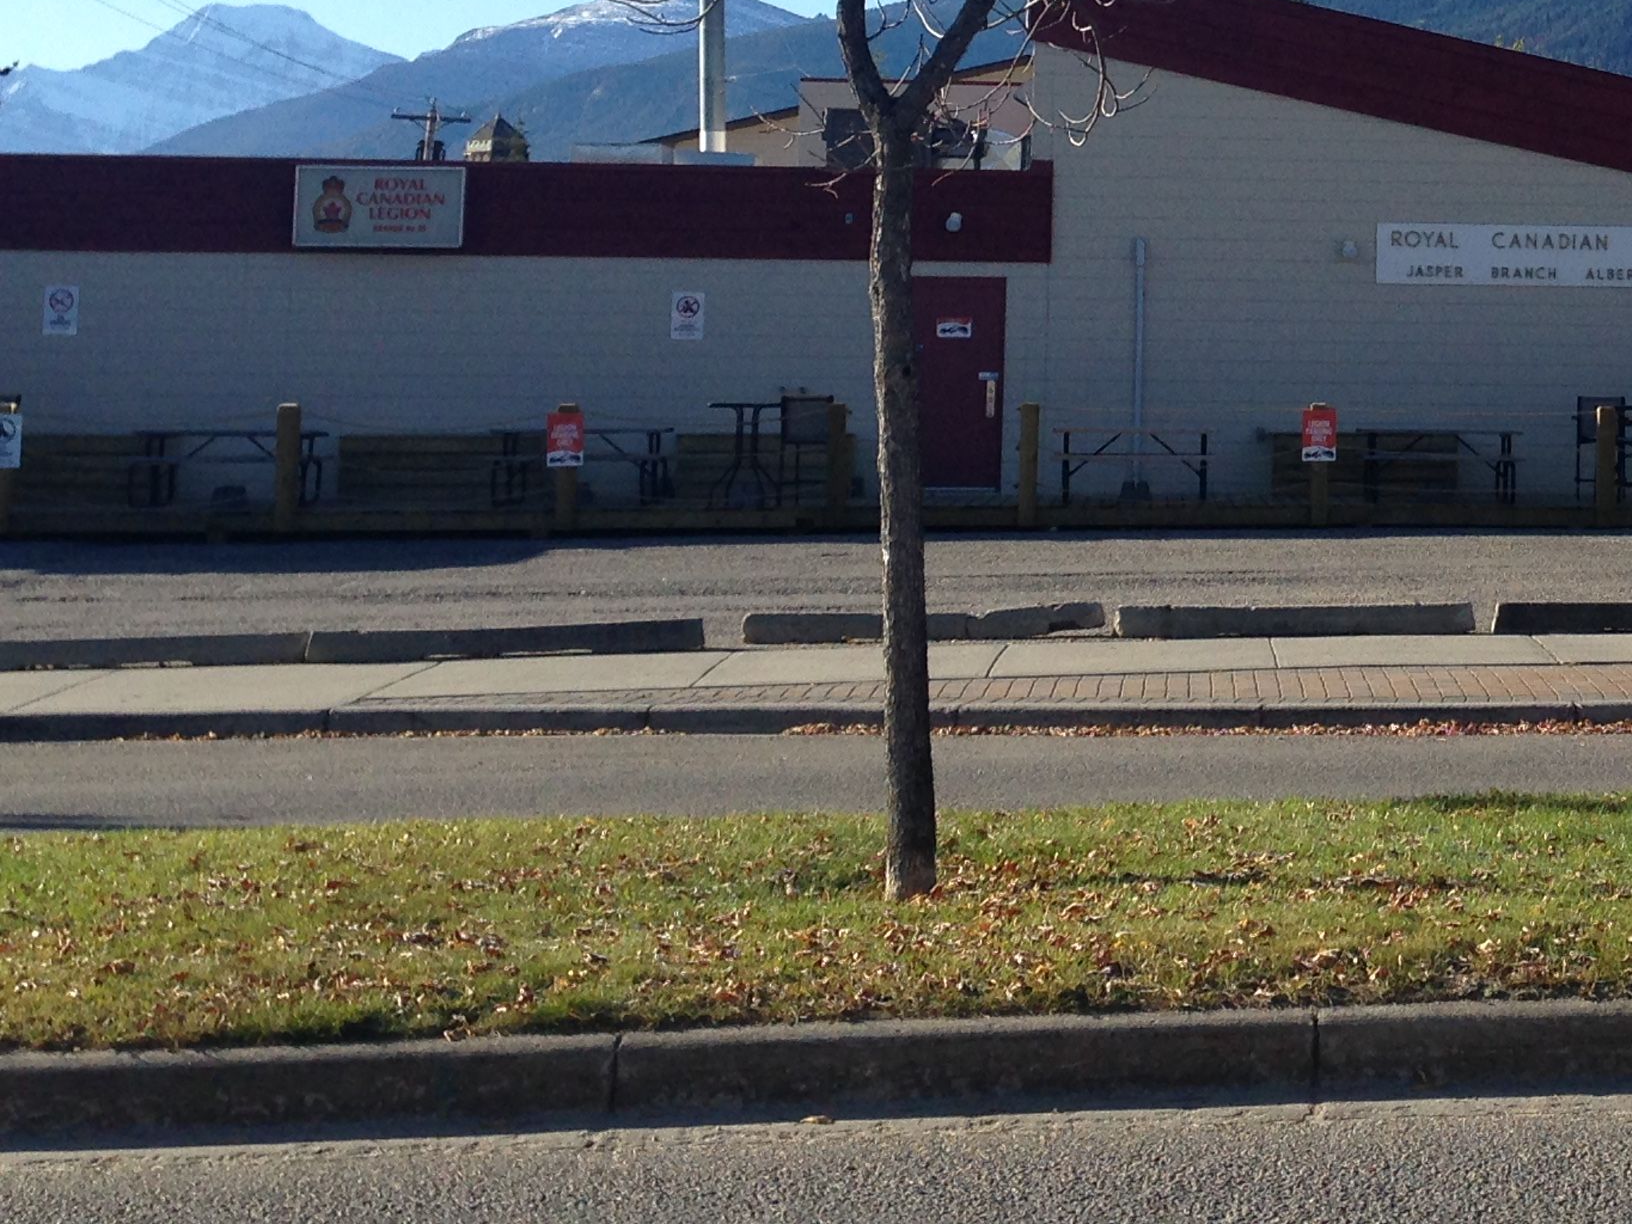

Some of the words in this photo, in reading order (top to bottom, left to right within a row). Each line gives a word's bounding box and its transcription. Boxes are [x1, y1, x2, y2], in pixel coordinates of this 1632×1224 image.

[374, 177, 428, 190] ROYAL
[356, 192, 445, 206] CANADIAN
[369, 207, 431, 220] LEGION
[1390, 230, 1459, 250] ROYAL
[1491, 231, 1609, 251] CANADIAN
[1406, 265, 1463, 279] JASPER
[1491, 266, 1557, 280] BRANCH
